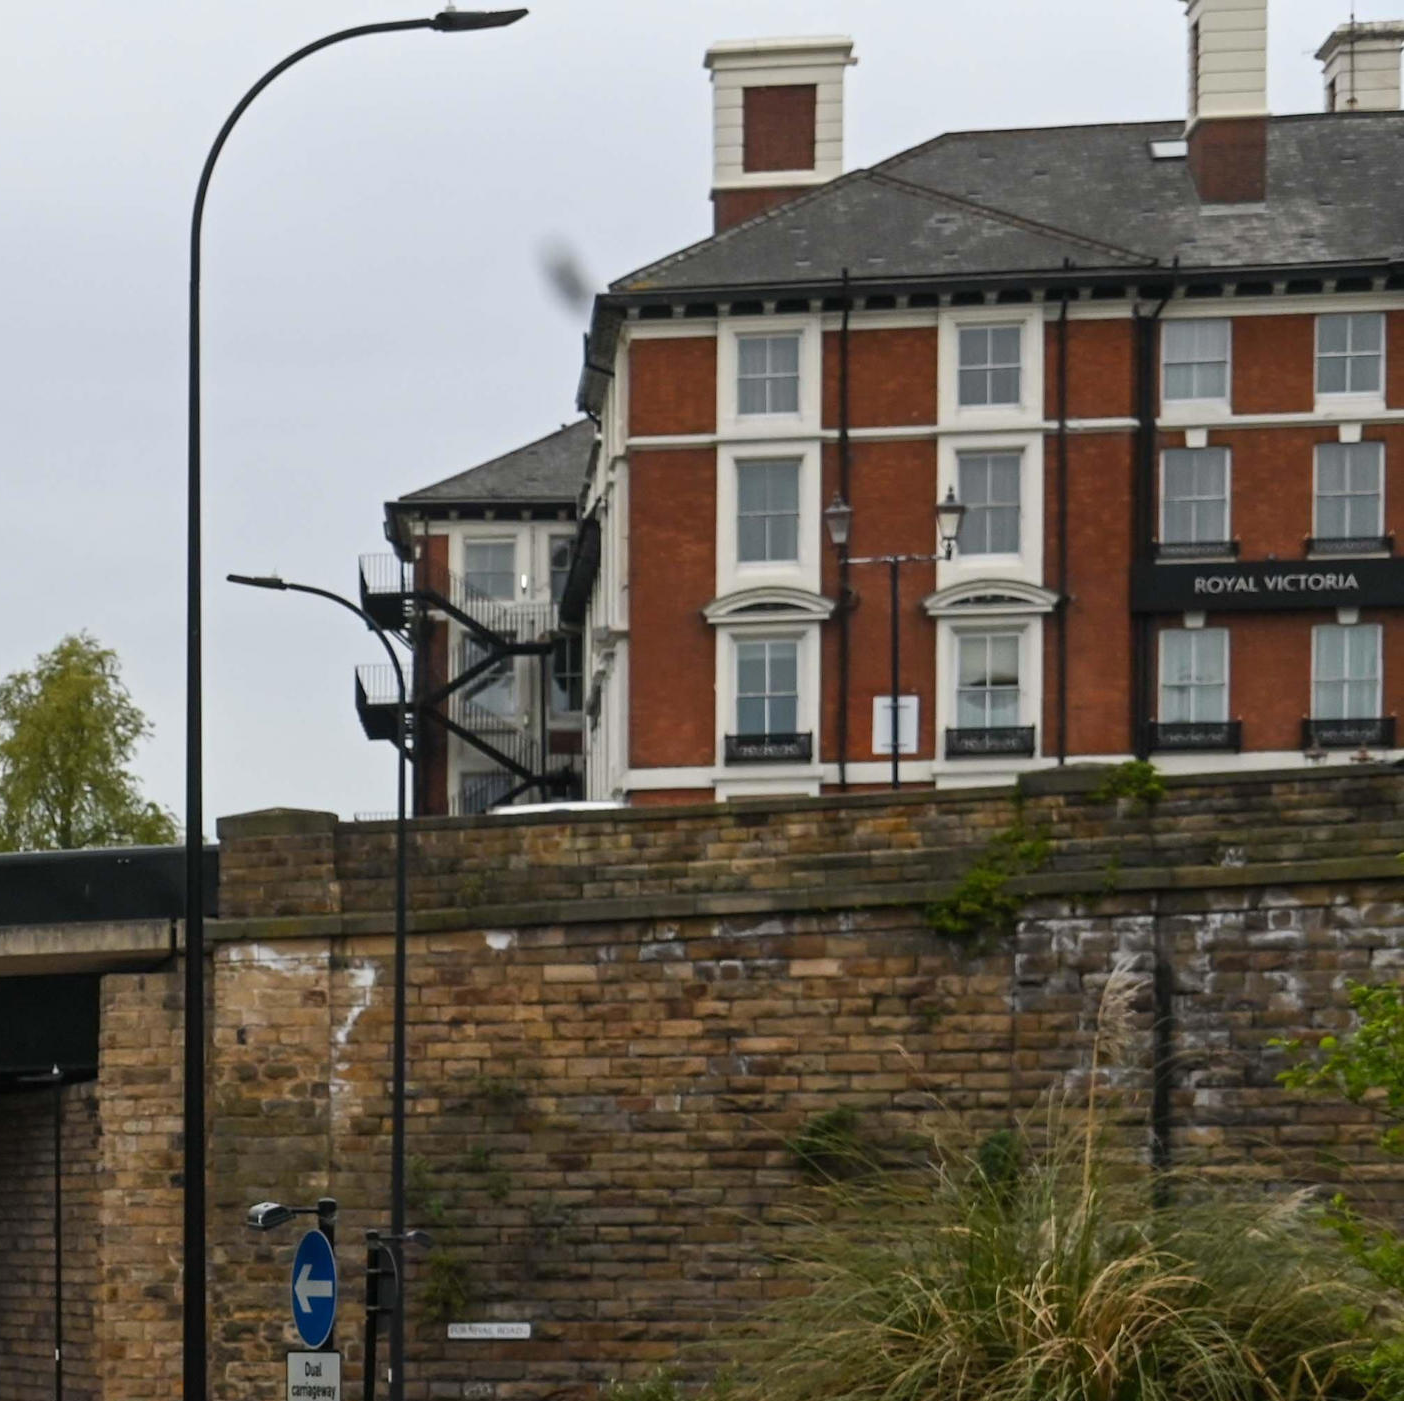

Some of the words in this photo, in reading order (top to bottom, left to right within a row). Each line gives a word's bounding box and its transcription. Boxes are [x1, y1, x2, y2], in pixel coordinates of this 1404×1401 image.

[1194, 576, 1259, 594] ROYAL
[1263, 573, 1360, 592] VICTORIA
[305, 1361, 322, 1377] Dual
[291, 1381, 336, 1401] carriageway
